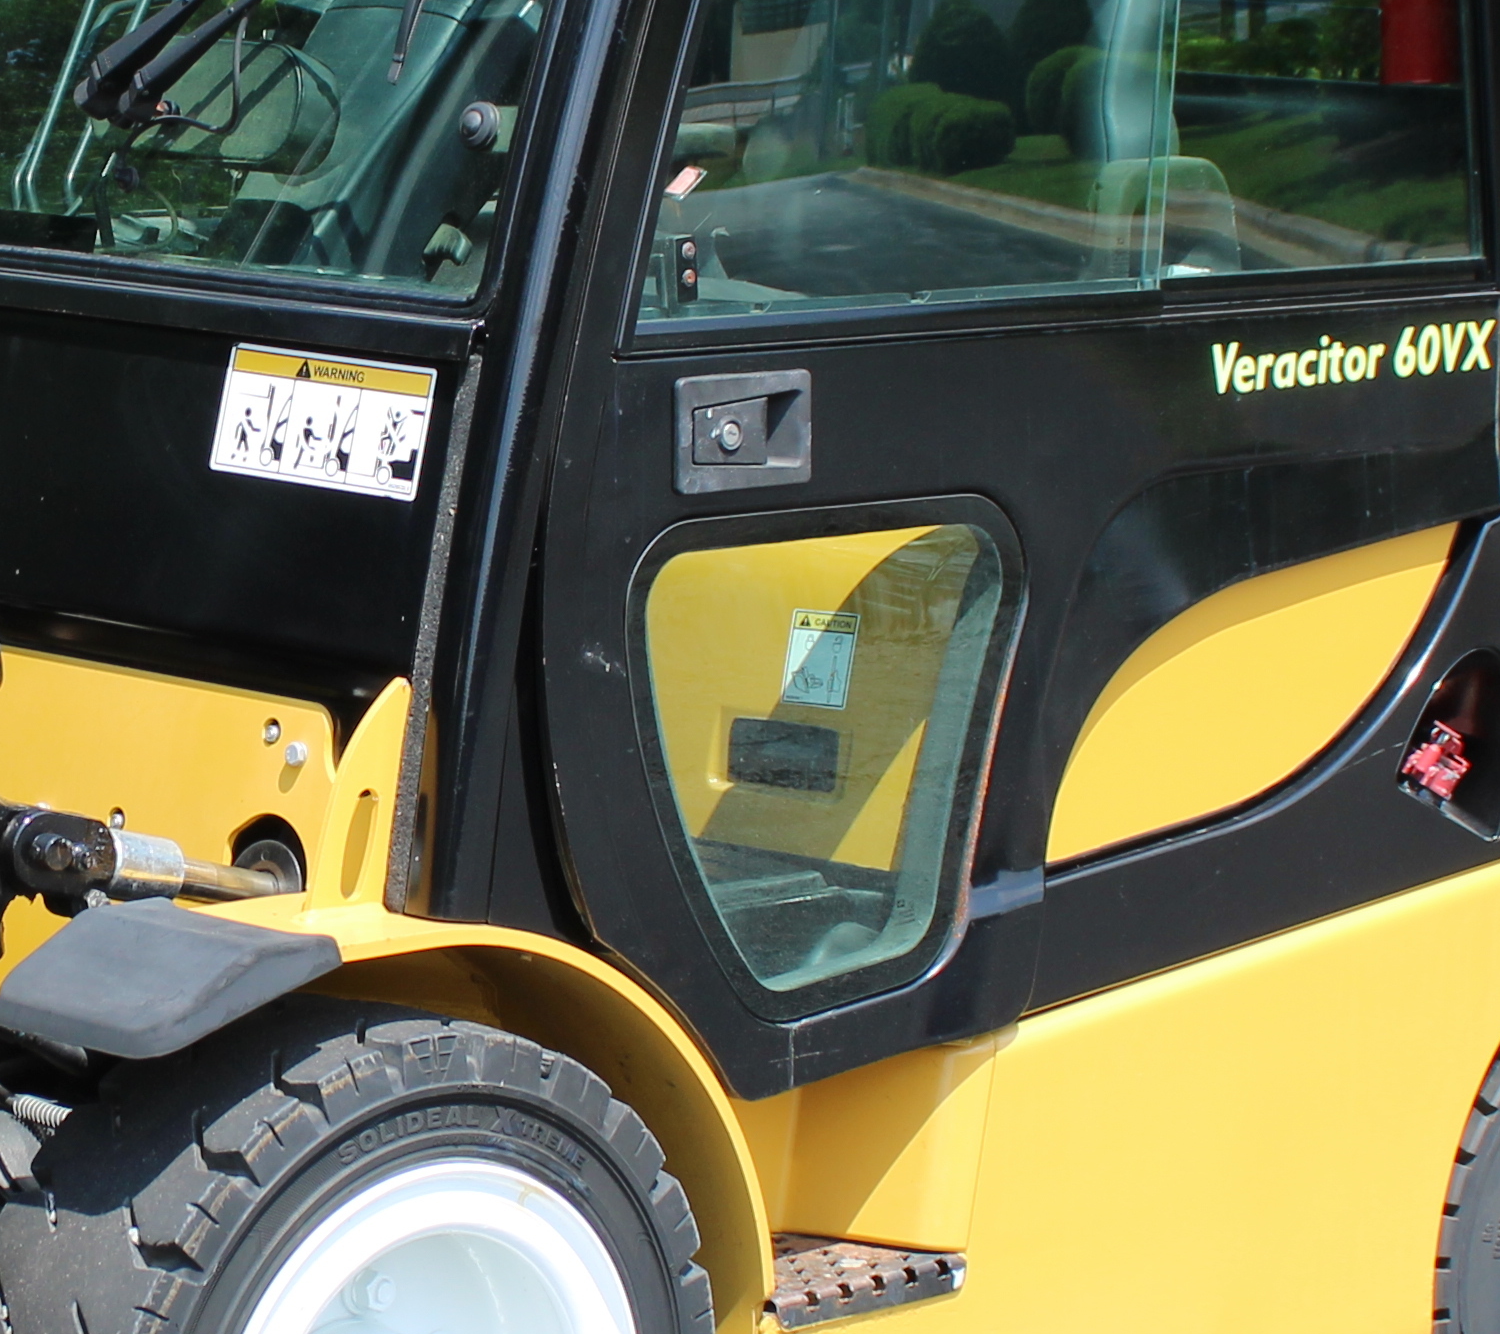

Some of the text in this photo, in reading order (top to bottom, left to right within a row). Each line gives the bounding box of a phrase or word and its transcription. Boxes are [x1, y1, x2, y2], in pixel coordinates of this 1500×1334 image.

[312, 364, 366, 384] WARNING
[1211, 318, 1497, 396] Veracitor 60VX
[814, 618, 853, 629] CAUTION
[338, 1105, 481, 1165] SOLIDEAL
